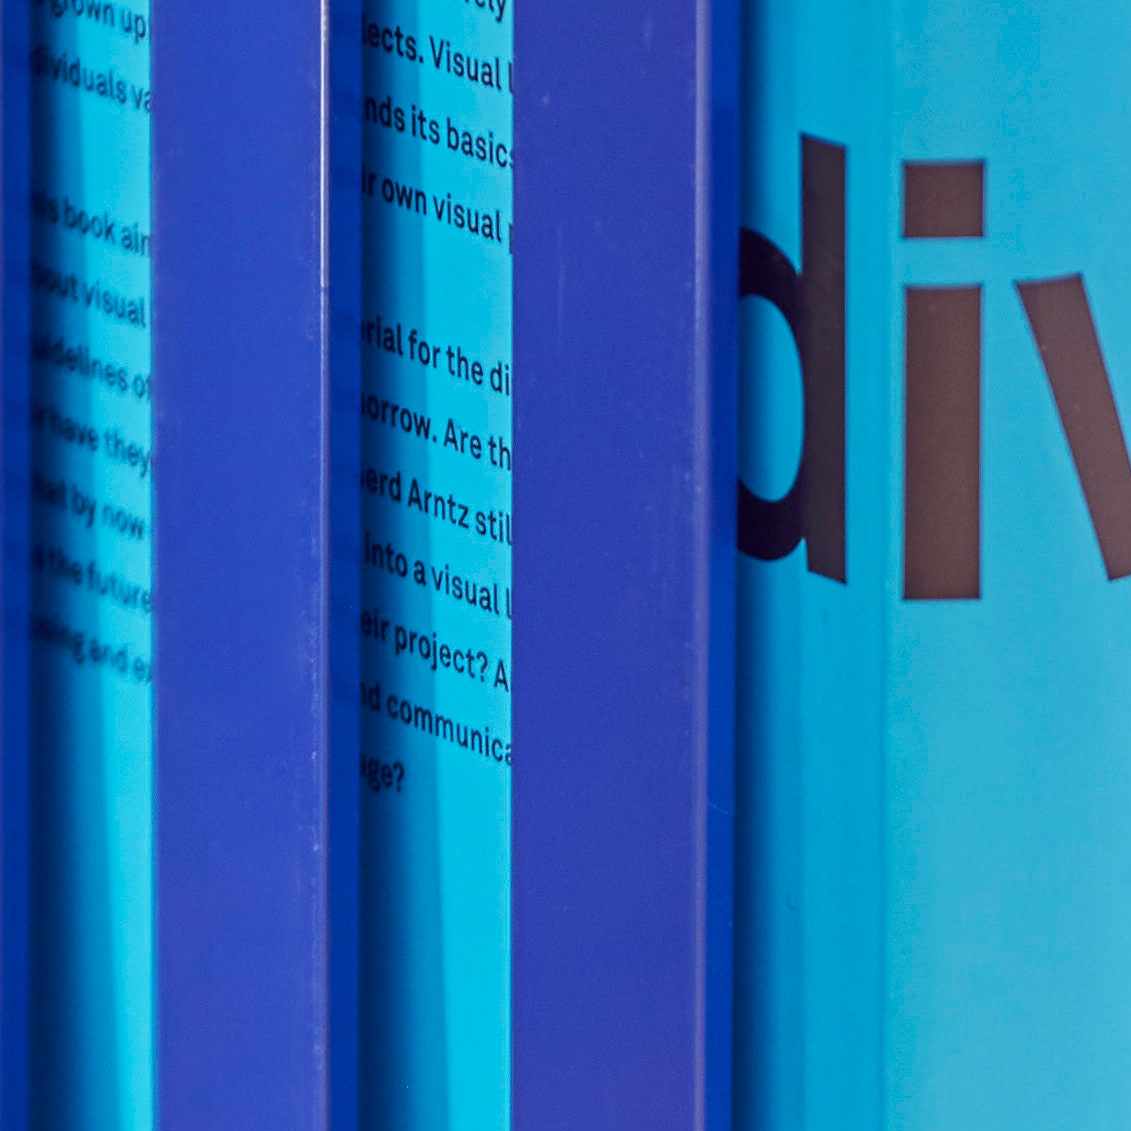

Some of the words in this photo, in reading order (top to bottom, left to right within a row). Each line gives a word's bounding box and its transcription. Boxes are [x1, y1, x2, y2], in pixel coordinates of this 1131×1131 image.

[121, 8, 146, 44] up
[429, 36, 501, 91] Visual
[411, 105, 440, 145] its
[64, 197, 115, 245] book
[382, 178, 426, 216] own
[433, 194, 502, 243] visual
[408, 328, 441, 368] for
[446, 345, 484, 386] the
[490, 361, 509, 396] di
[444, 418, 482, 460] Are
[103, 500, 145, 540] now
[407, 478, 469, 530] Arntz
[414, 560, 426, 586] a
[431, 563, 498, 616] visual
[395, 626, 489, 684] project?
